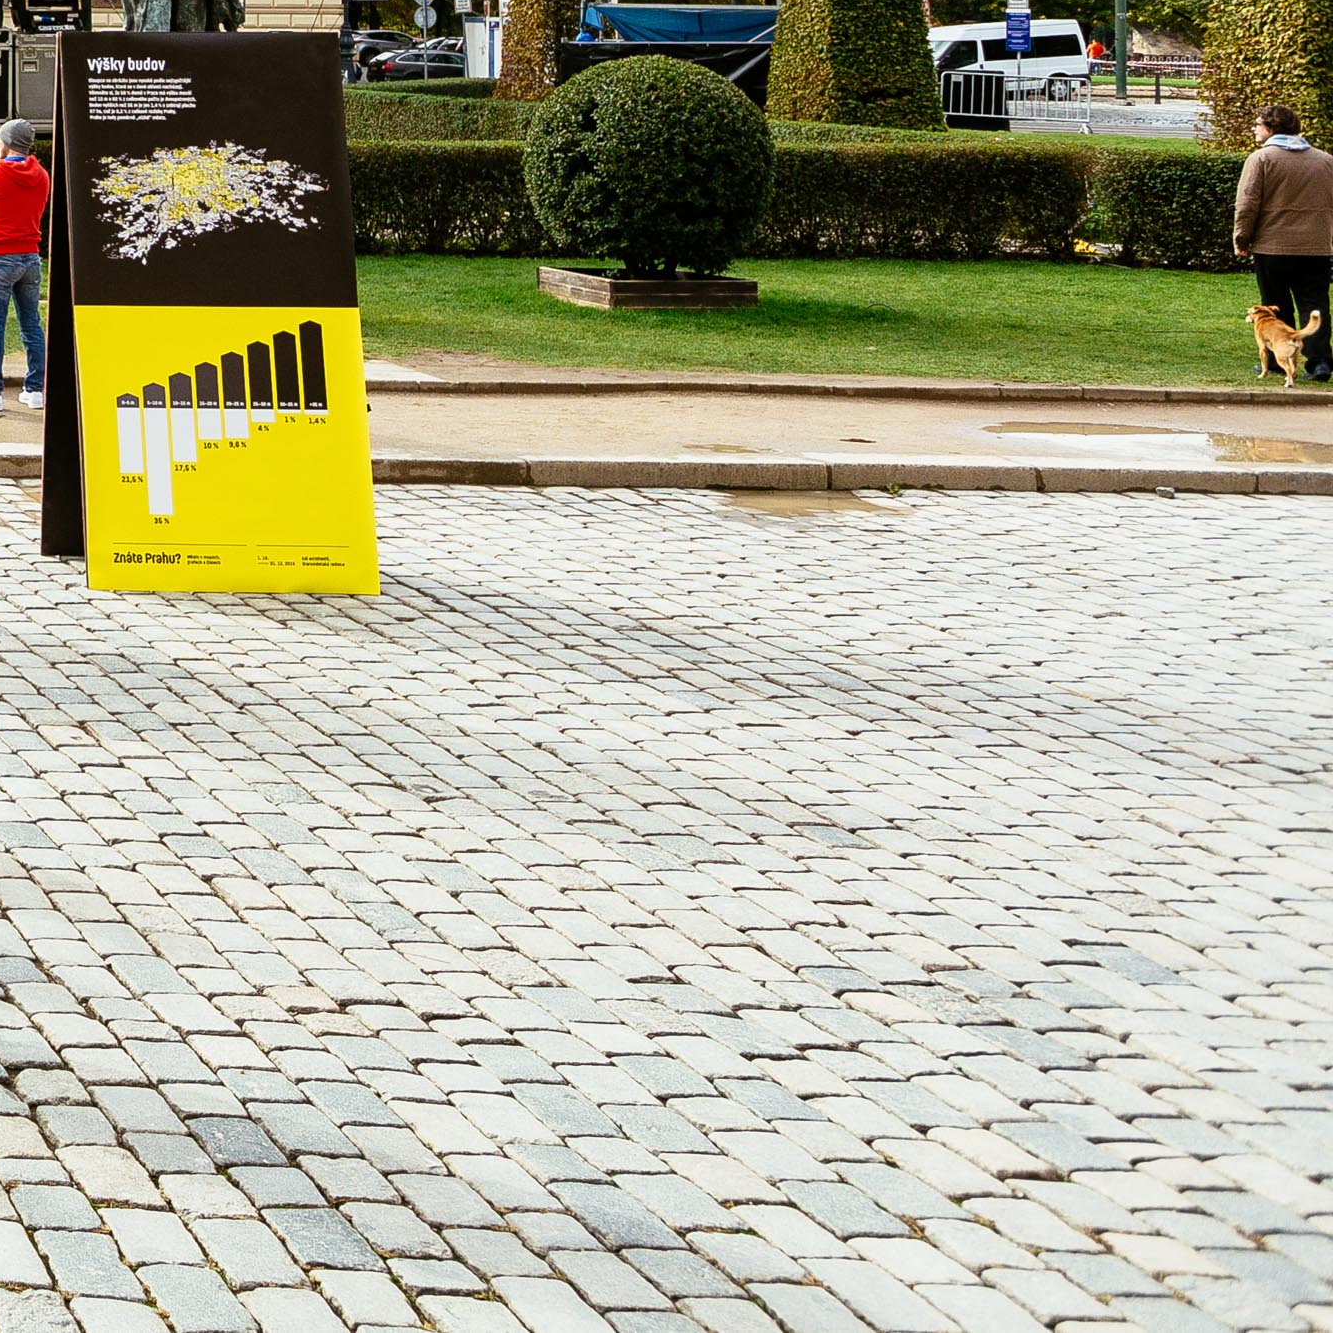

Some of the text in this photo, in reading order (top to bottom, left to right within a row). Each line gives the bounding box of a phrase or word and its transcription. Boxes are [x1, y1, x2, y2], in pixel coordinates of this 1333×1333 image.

[87, 57, 165, 74] Výšky budov
[114, 552, 181, 564] Znáte Prahu?
